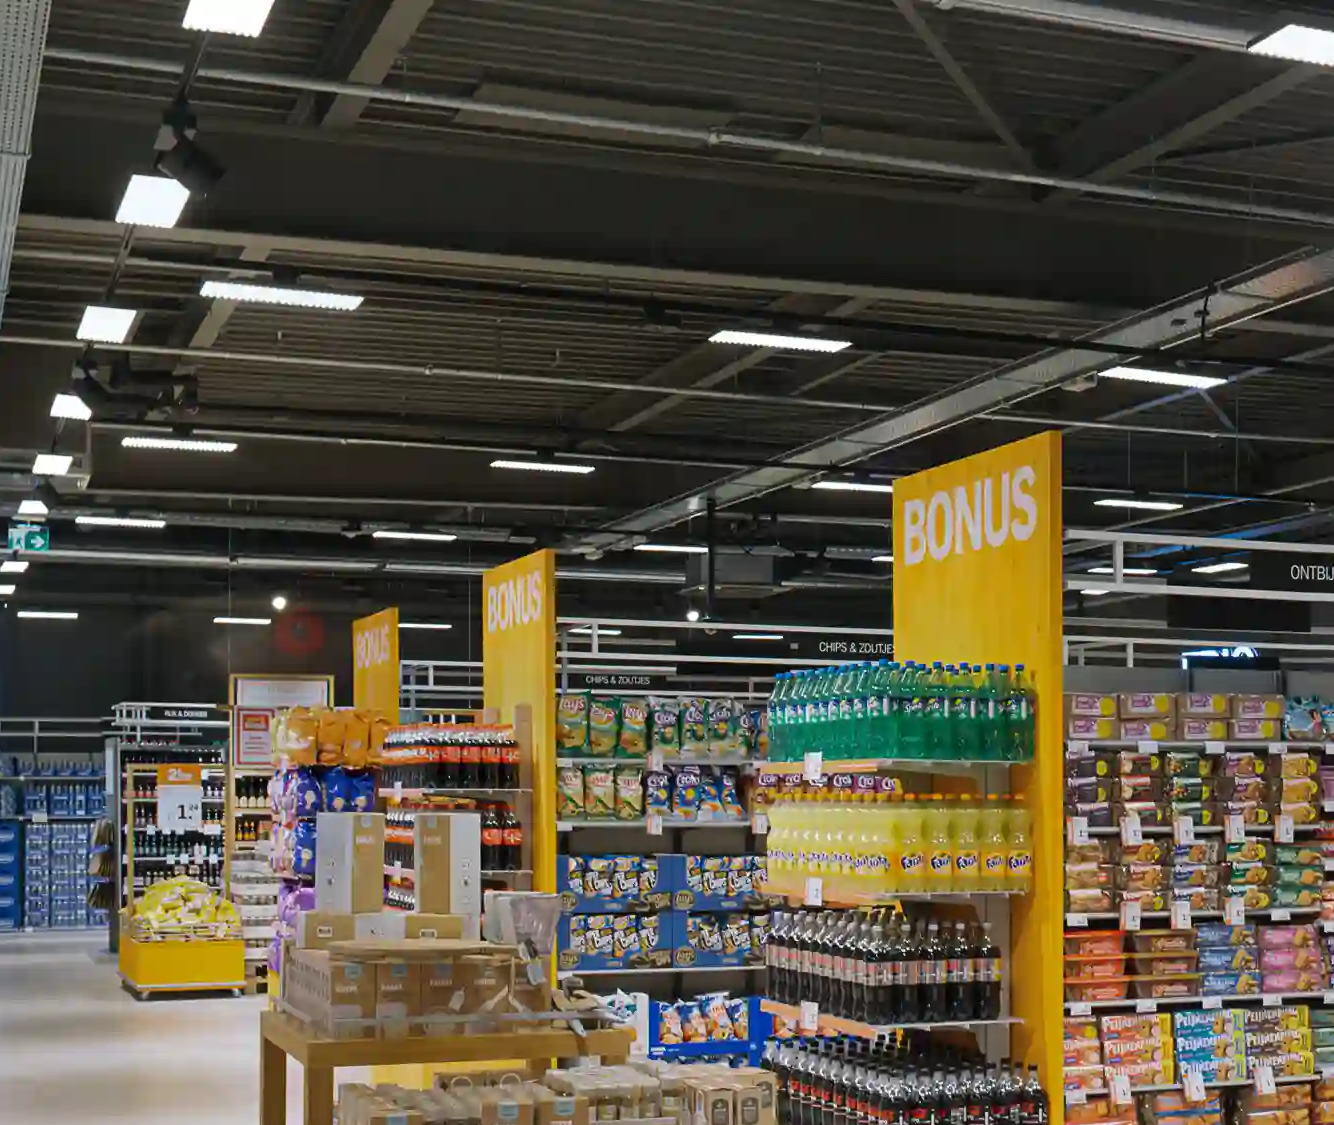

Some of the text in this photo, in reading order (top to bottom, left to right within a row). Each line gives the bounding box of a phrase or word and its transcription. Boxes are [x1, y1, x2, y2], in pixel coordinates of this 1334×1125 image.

[903, 465, 1037, 567] BONUS
[487, 570, 542, 633] BONUS
[356, 623, 390, 669] BONUS
[819, 642, 847, 653] CHIPS
[849, 643, 856, 653] &
[586, 676, 609, 685] CHIPS
[611, 676, 617, 684] &
